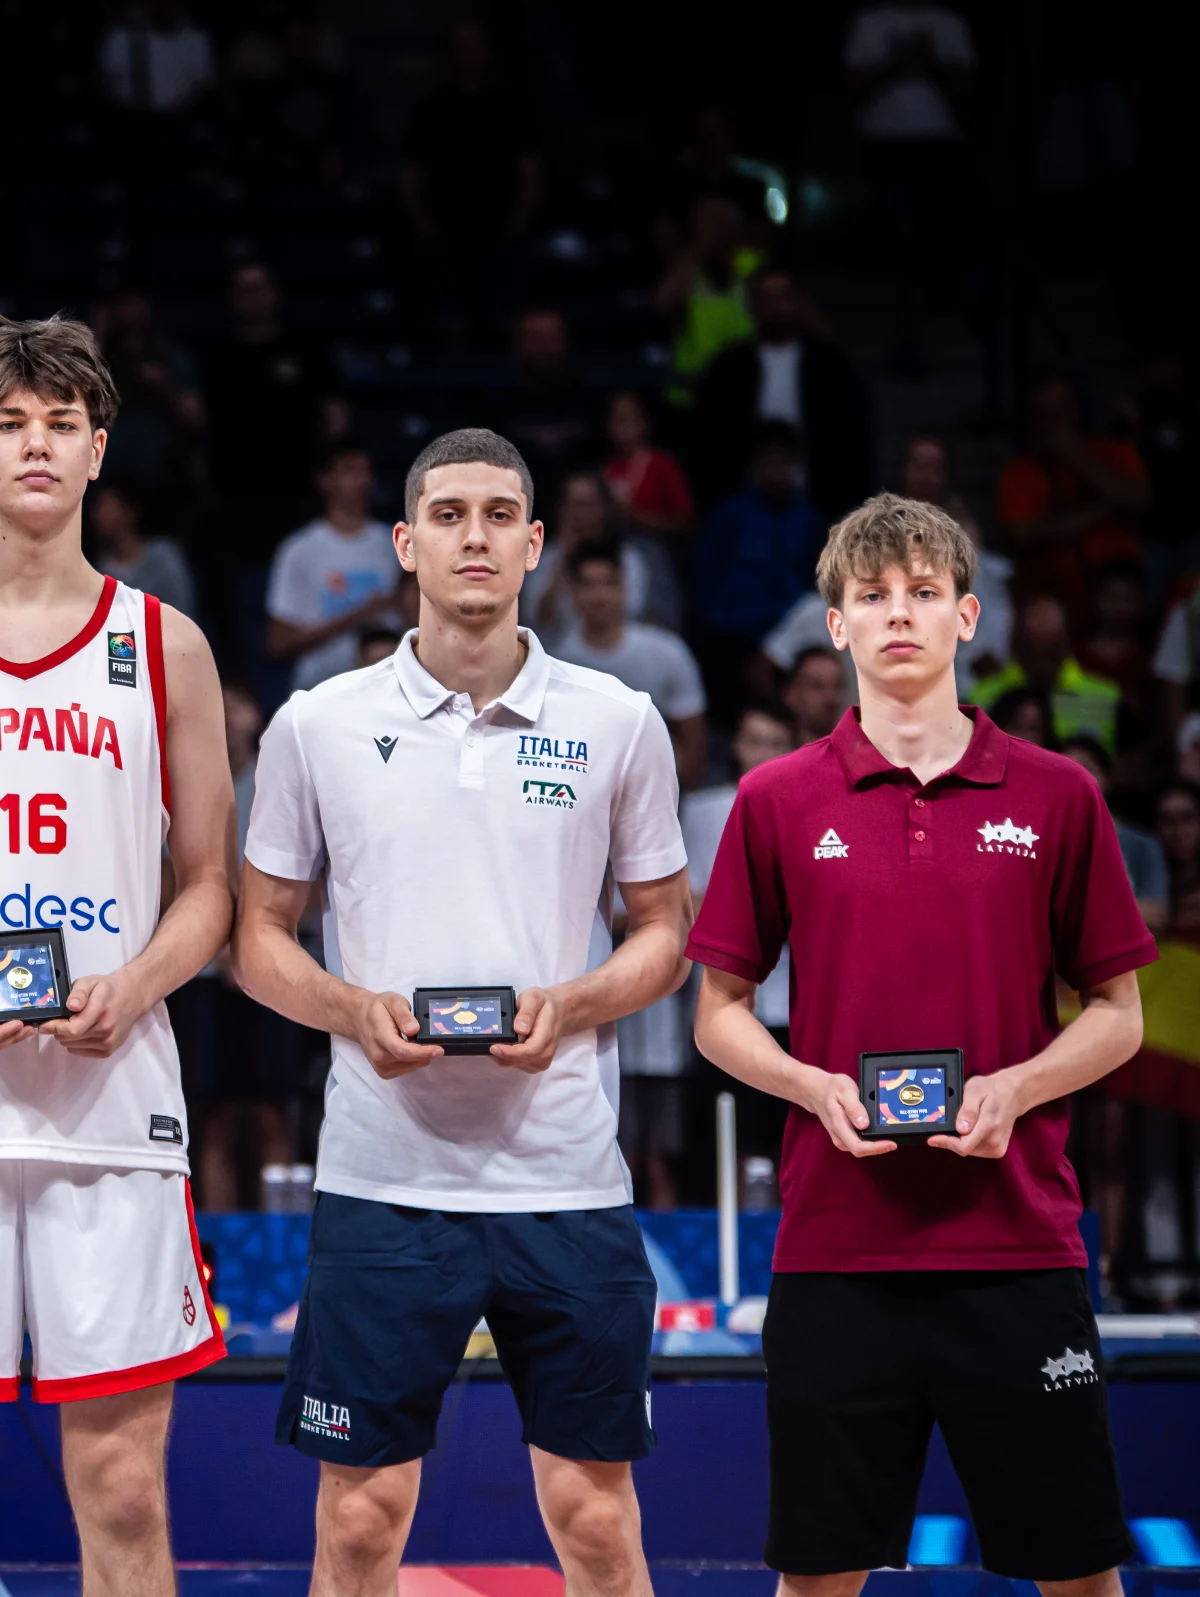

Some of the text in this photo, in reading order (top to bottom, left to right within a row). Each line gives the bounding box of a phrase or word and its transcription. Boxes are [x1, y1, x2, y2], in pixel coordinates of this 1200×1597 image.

[112, 662, 132, 674] FIBA
[517, 735, 588, 762] ITALIA
[517, 759, 588, 774] BASKETBALL
[522, 780, 578, 801] ITA
[525, 796, 575, 810] AIRWAYS
[813, 844, 850, 860] PEAK
[976, 843, 1037, 860] LATVIJA
[302, 1395, 351, 1429] ITALIA
[300, 1420, 351, 1441] BASKETBALL
